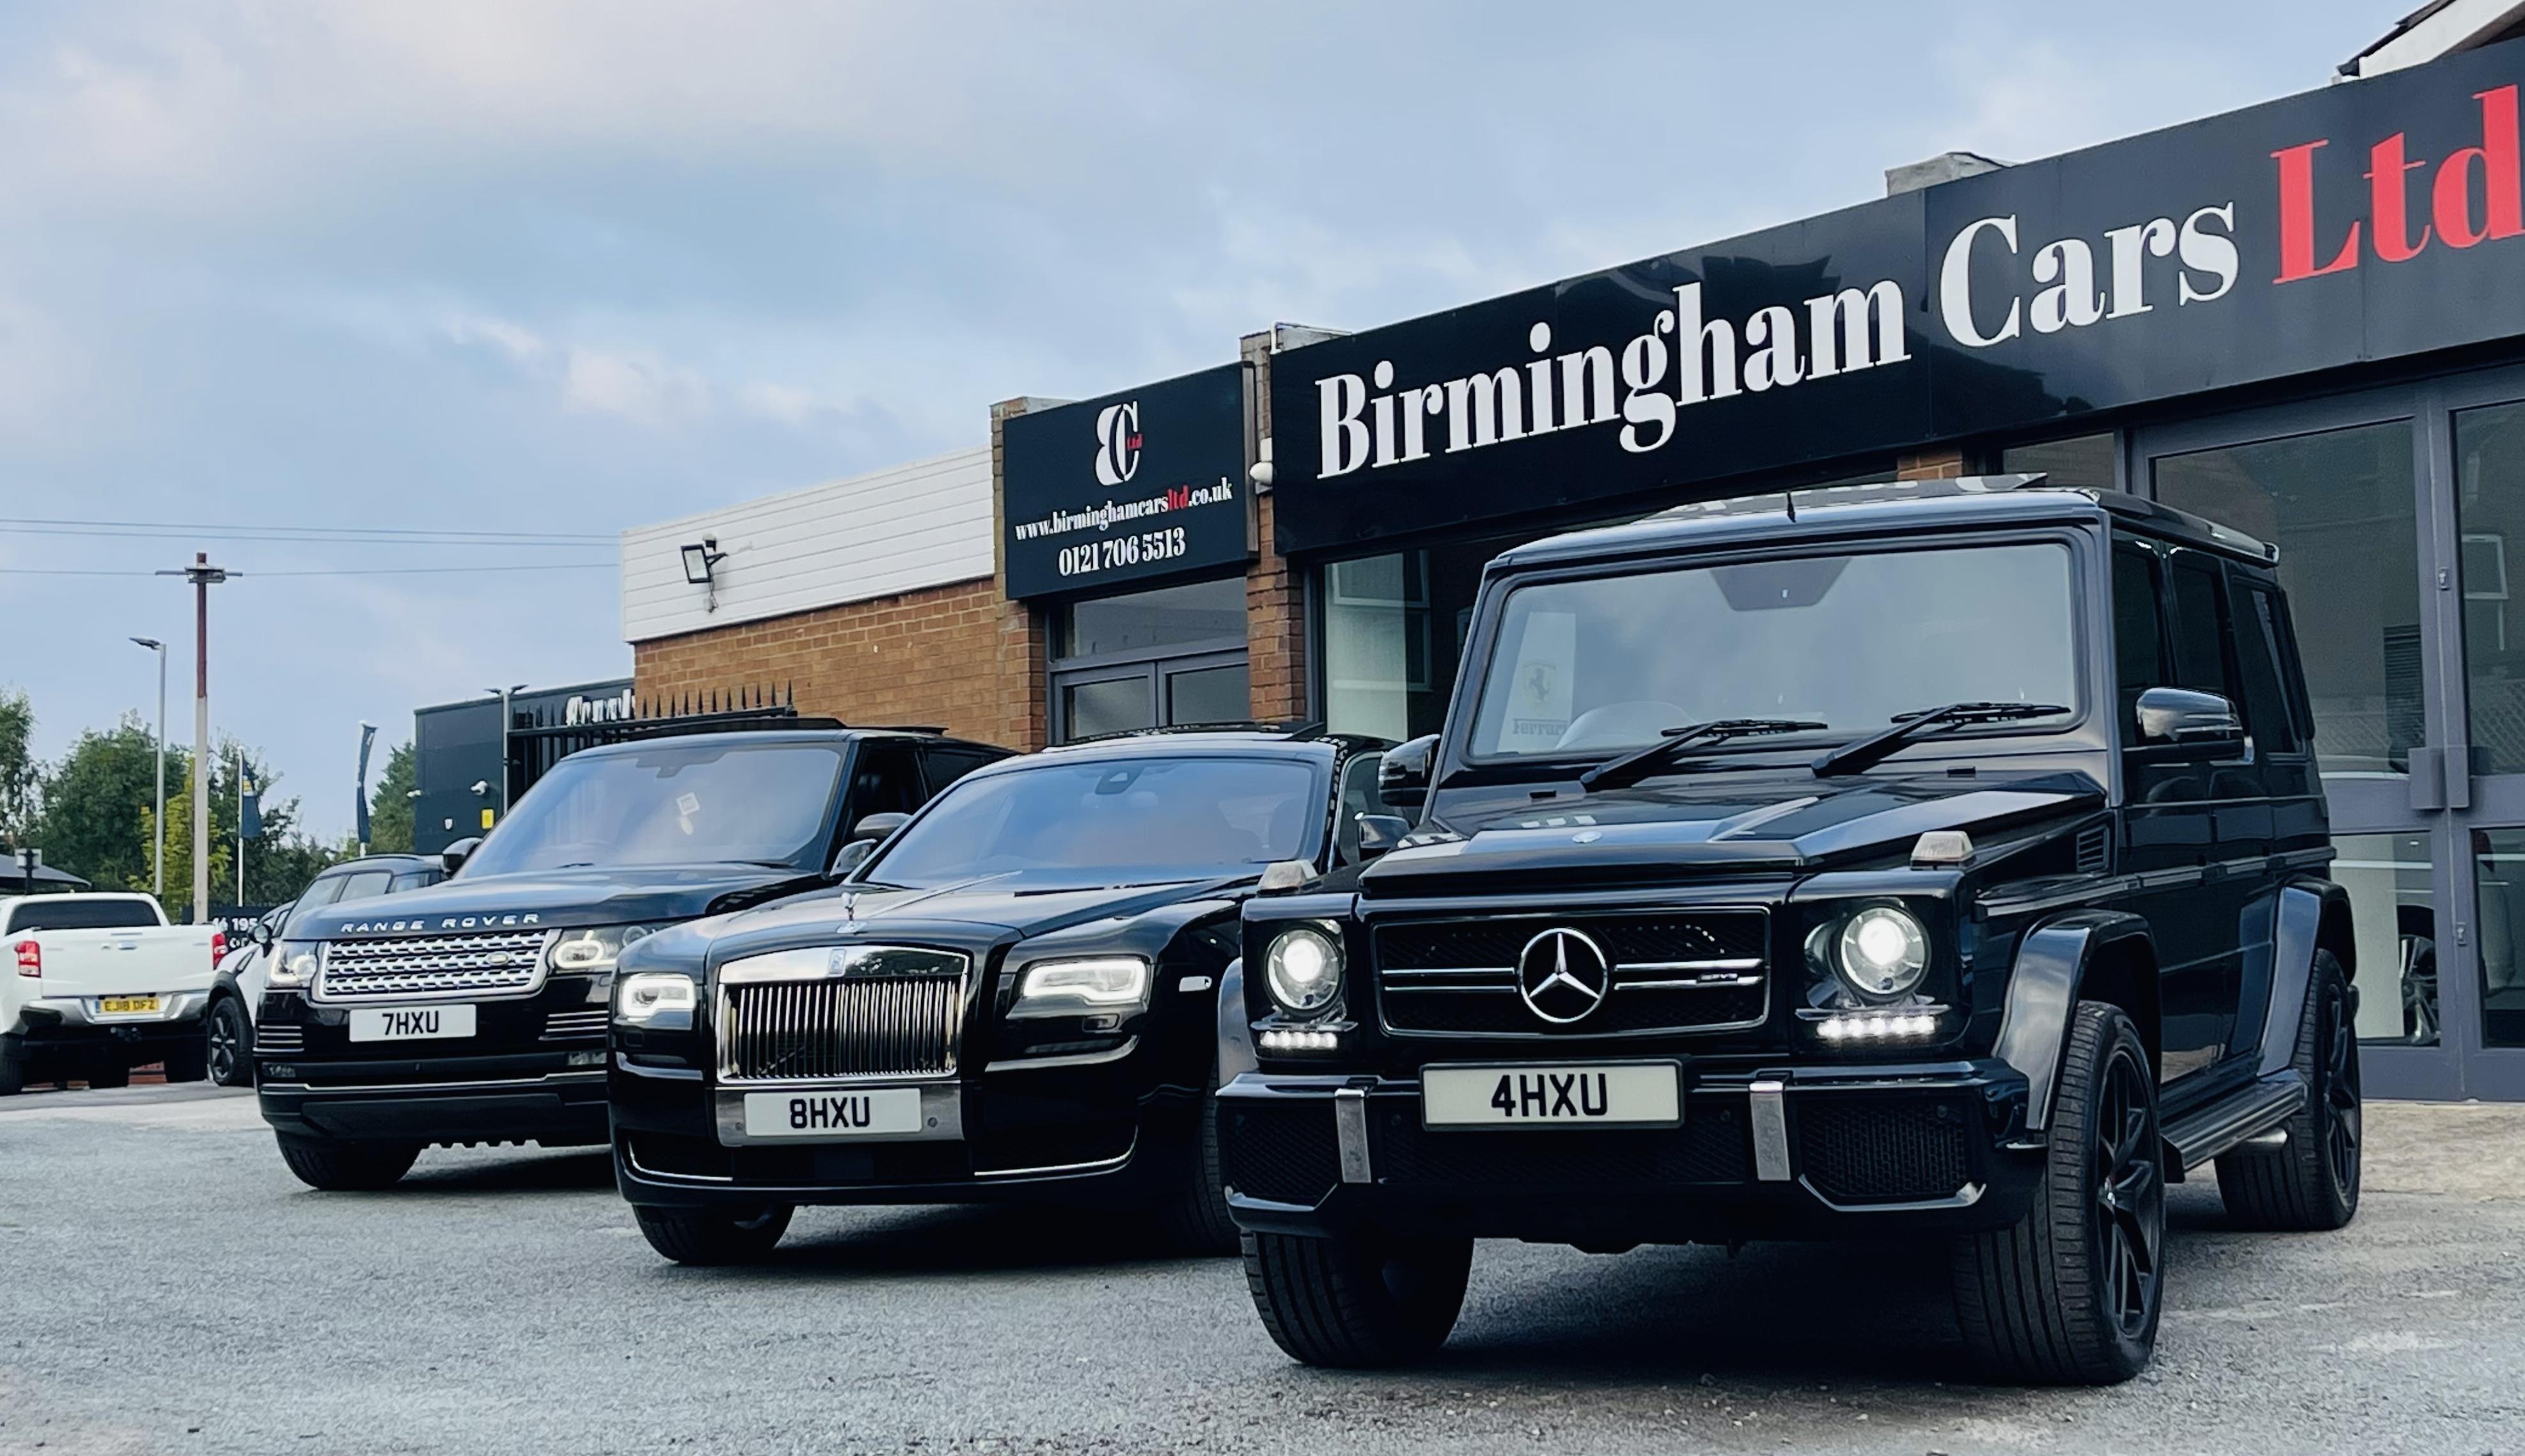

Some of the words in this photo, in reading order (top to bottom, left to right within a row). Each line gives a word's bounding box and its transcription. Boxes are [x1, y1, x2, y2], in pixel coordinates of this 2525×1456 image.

[1315, 279, 1911, 479] Birmingham
[1940, 200, 2240, 348] Cars
[2270, 84, 2525, 285] Ltd
[1015, 476, 1233, 541] www.birminghamcarsltd.co.uk
[1058, 542, 1099, 576] 0121
[1103, 535, 1139, 570] 706
[1142, 526, 1186, 563] 5513
[340, 920, 425, 934] RANGE
[441, 912, 540, 928] ROVER
[382, 1010, 439, 1036] 7HXU
[789, 1096, 870, 1129] 8HXU
[1491, 1073, 1609, 1118] 4HXU
